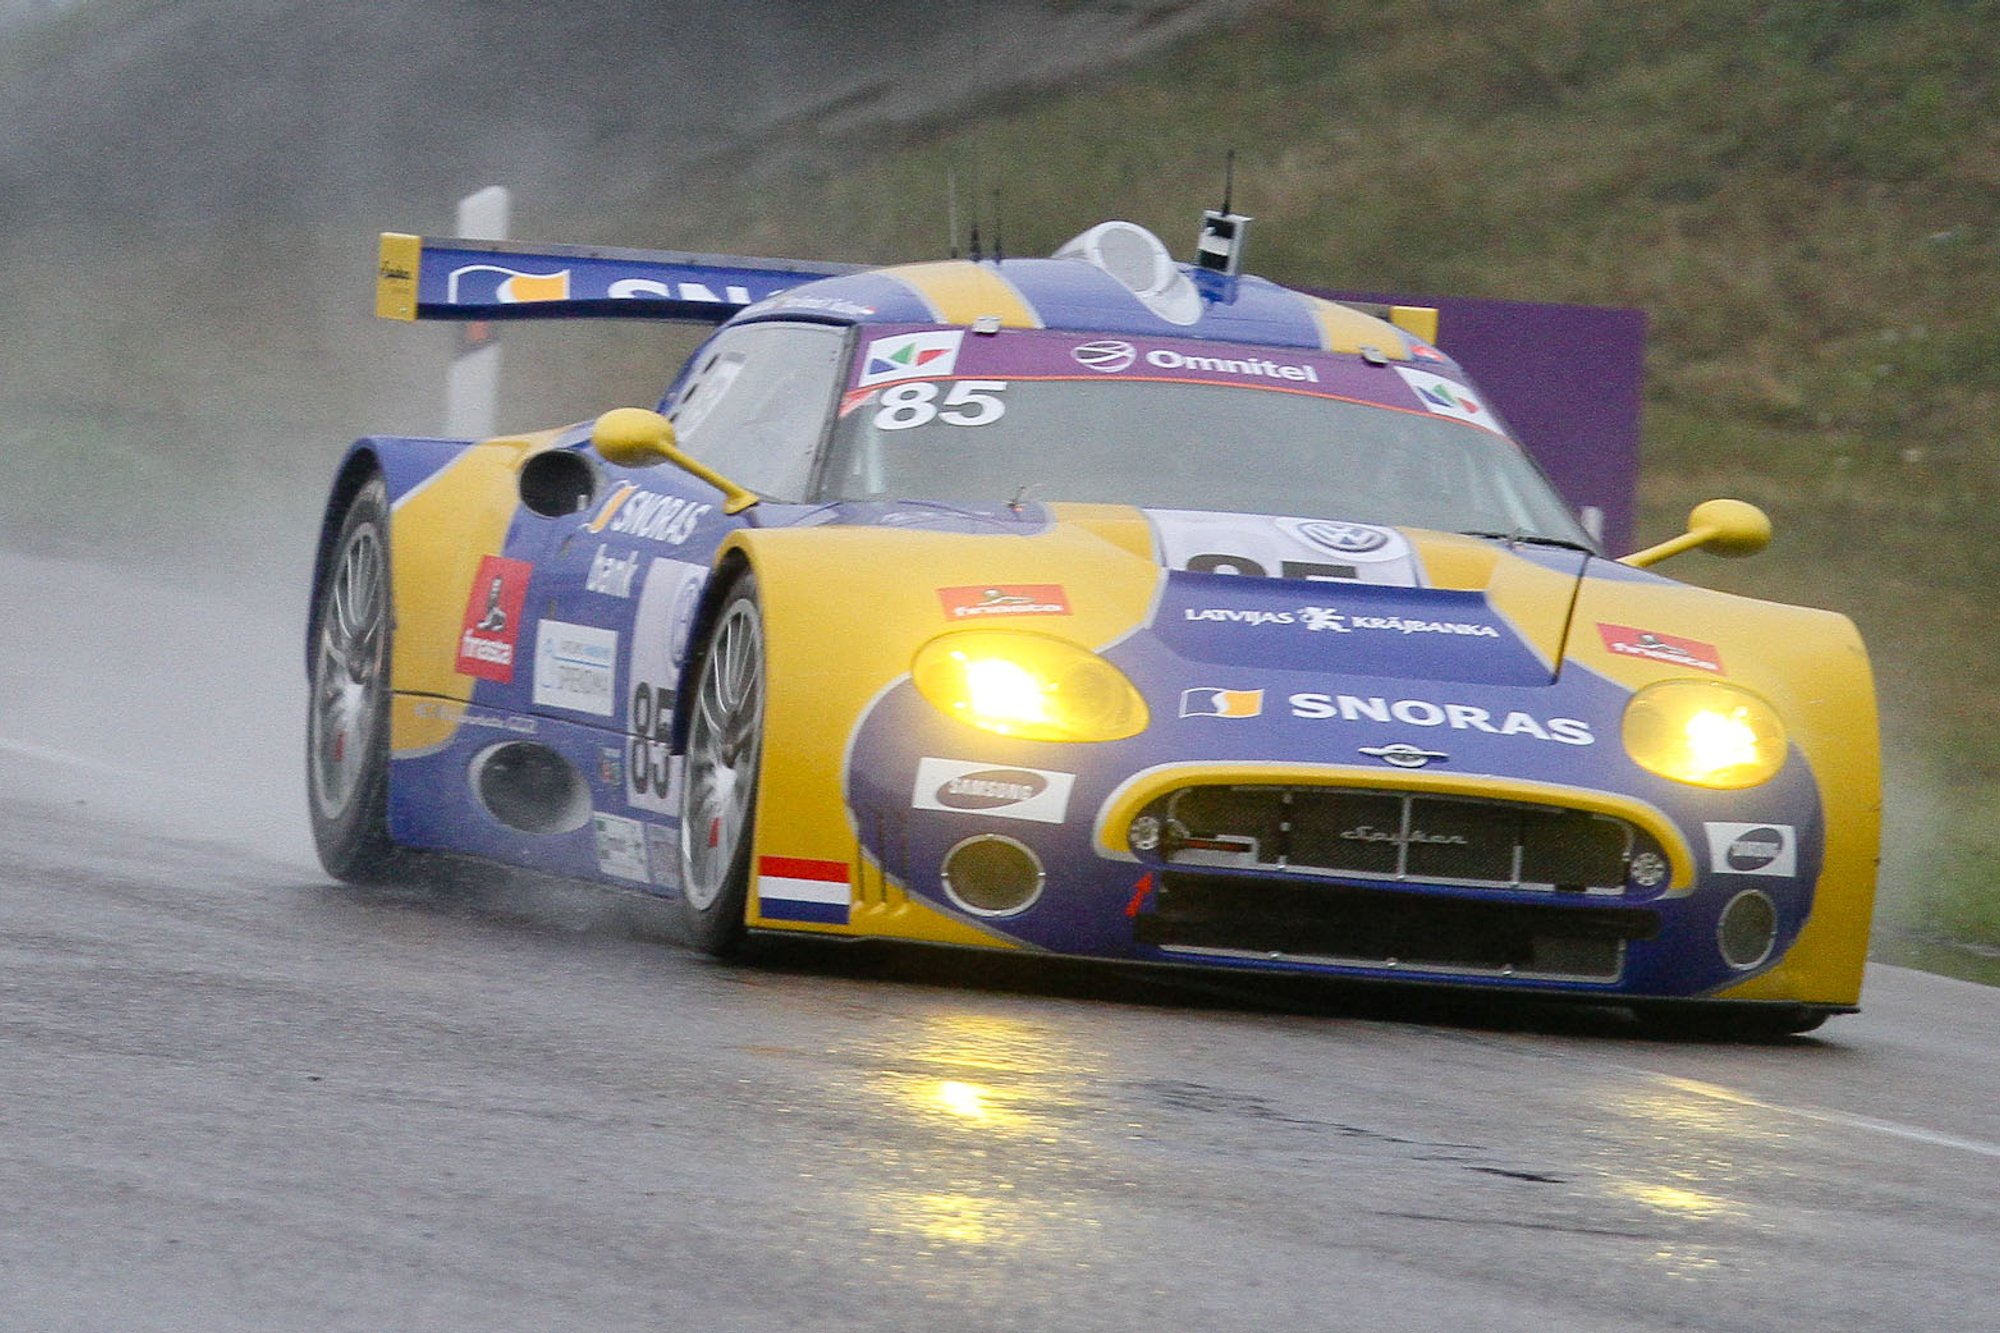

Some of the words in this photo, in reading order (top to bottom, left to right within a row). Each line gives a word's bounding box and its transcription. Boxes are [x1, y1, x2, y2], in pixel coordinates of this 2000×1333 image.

[1146, 350, 1320, 383] Omnitel
[874, 380, 1008, 430] 85
[610, 490, 713, 545] SNORAS
[1184, 608, 1296, 626] LATVIJAS
[1288, 692, 1597, 746] SNORAS
[948, 777, 1034, 800] SAMSUNG
